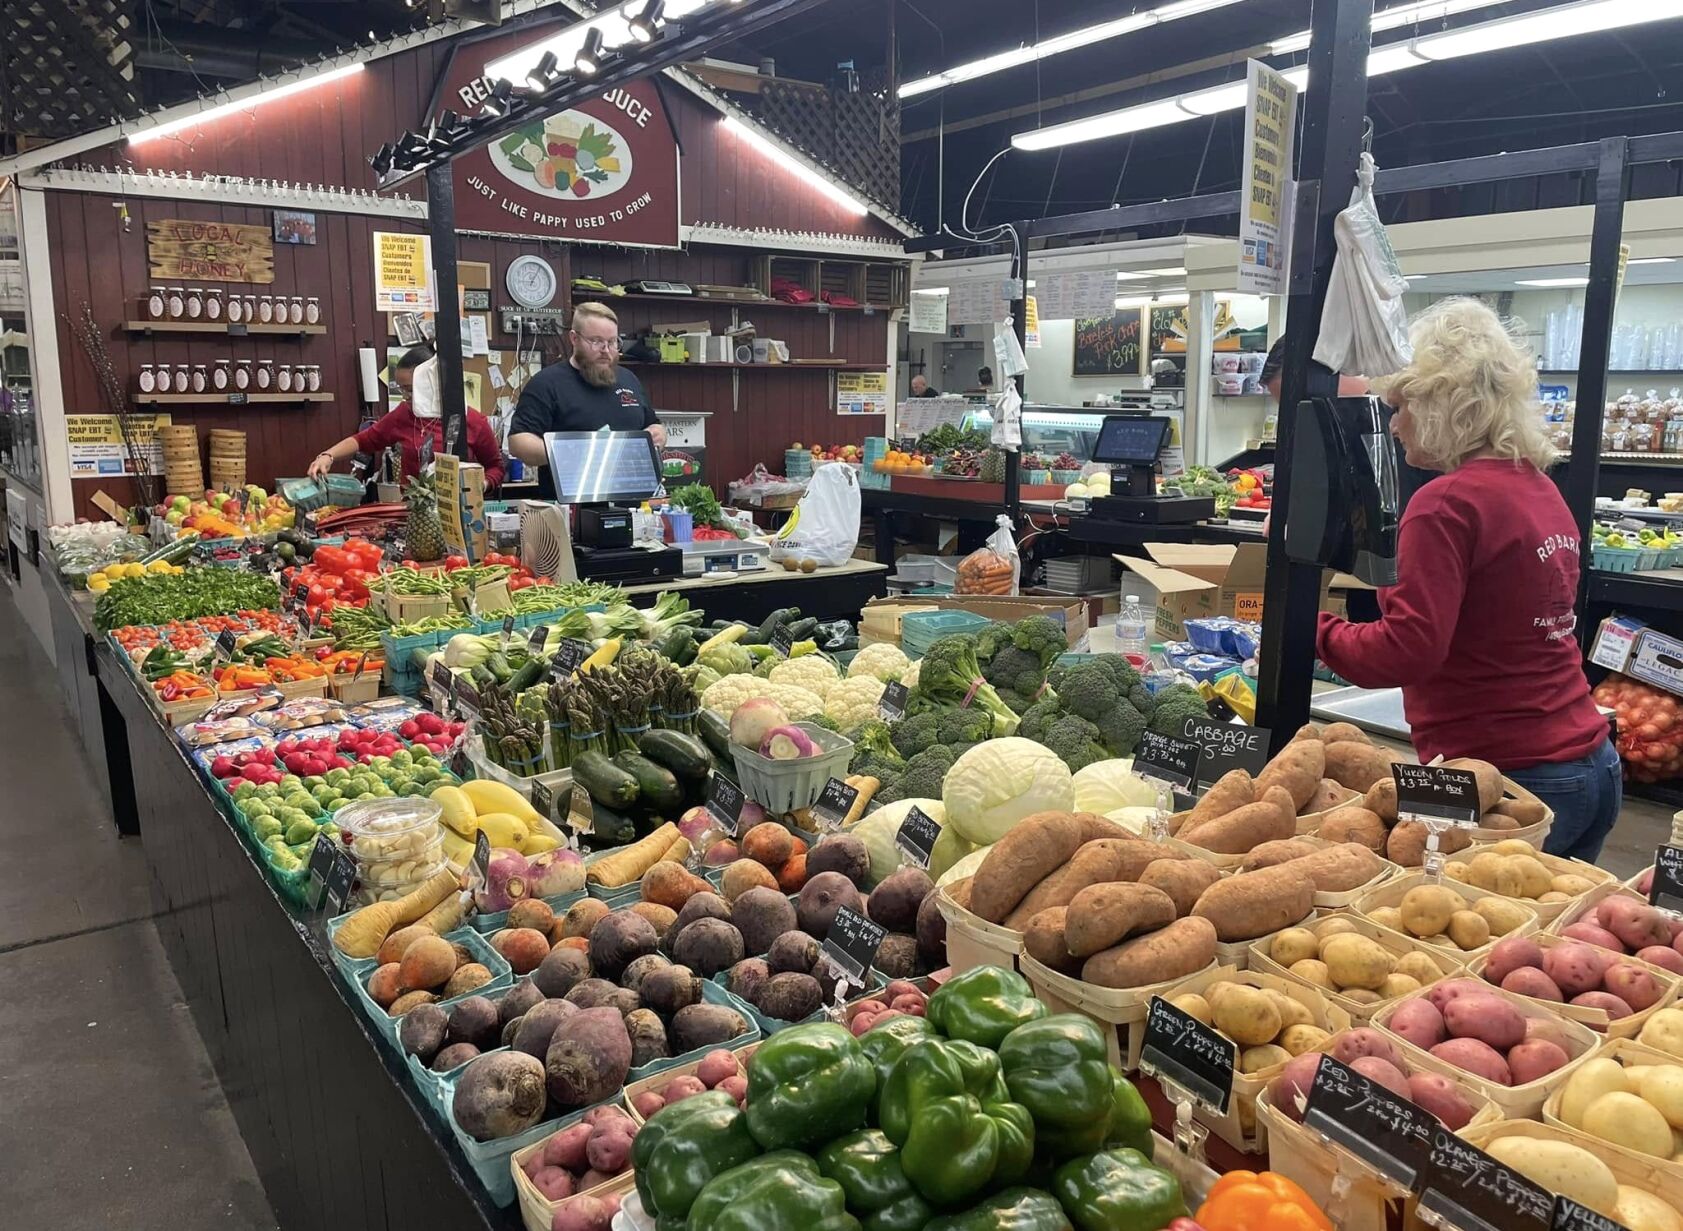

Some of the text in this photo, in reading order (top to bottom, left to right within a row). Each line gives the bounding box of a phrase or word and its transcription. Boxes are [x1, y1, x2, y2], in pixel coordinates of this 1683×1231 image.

[467, 175, 652, 228] JUST LIKE PAPPY USED TO GROW
[173, 225, 244, 246] LOCAL
[179, 259, 246, 278] HONEY
[1536, 536, 1556, 562] RED
[1155, 616, 1180, 634] PEPPERS
[1156, 606, 1174, 620] FRESH
[1184, 718, 1259, 750] CABBAGE
[1395, 764, 1471, 785] YUKON GOLDS
[1153, 1000, 1183, 1030] GREEN
[1321, 1058, 1349, 1082] RED
[1435, 1132, 1496, 1172] ORANGE
